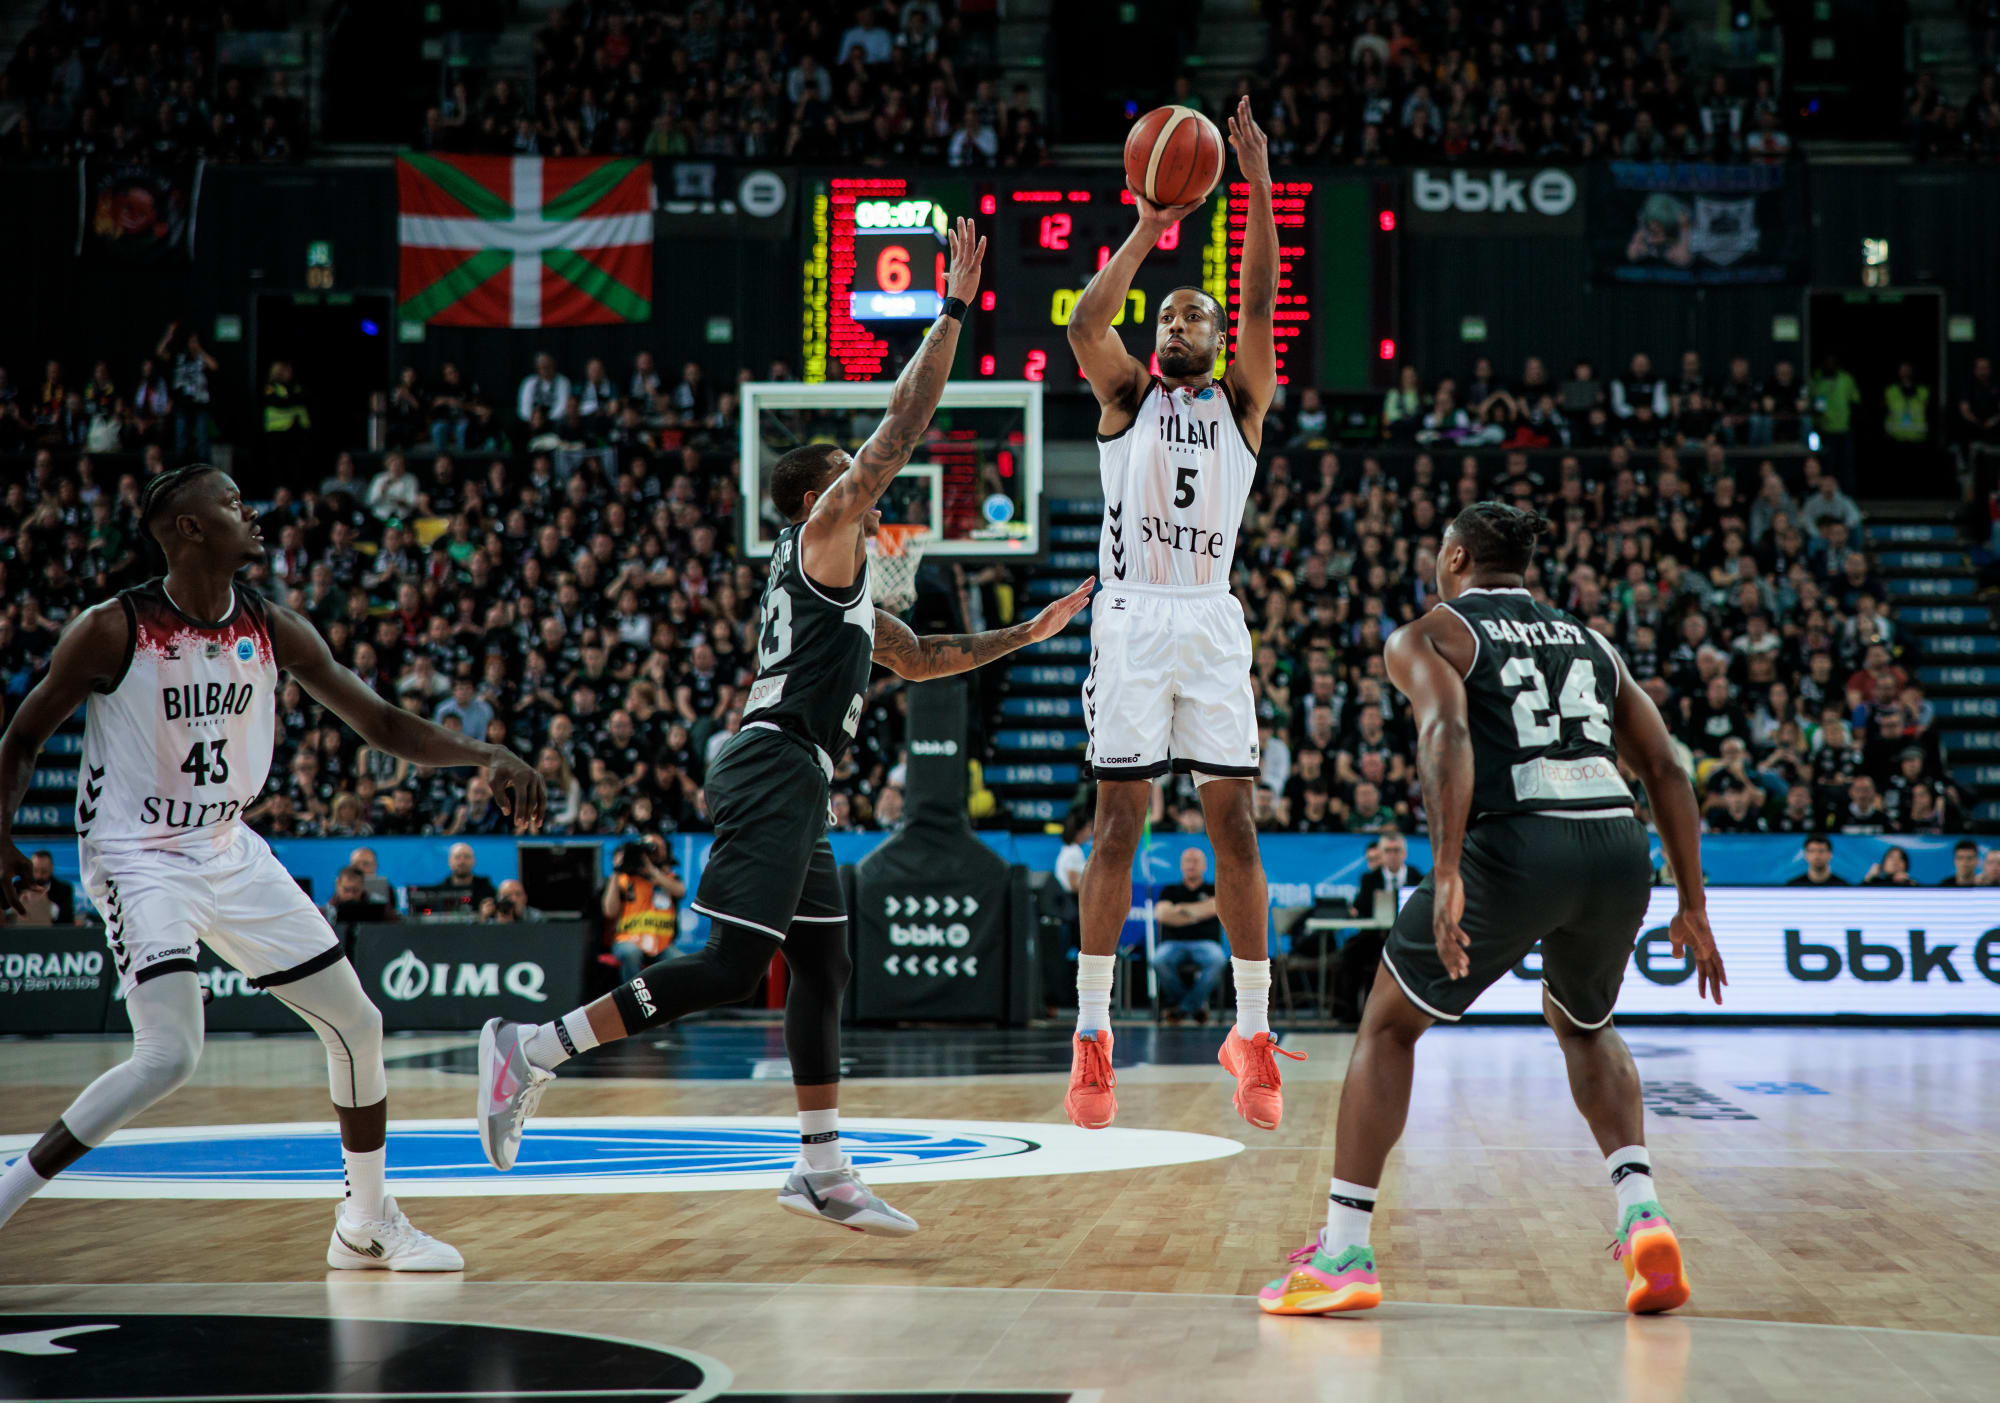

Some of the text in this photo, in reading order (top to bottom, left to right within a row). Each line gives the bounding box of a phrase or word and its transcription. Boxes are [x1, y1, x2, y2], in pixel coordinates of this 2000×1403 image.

[1413, 168, 1527, 213] bbk
[1040, 213, 1072, 250] 12
[876, 245, 911, 293] 6
[1024, 350, 1047, 381] 2
[1173, 467, 1198, 508] 5
[162, 682, 253, 721] BILBAO
[1500, 656, 1613, 748] 24
[1018, 732, 1066, 750] IMQ
[1106, 756, 1139, 764] CORREO
[181, 739, 228, 787] 43
[1005, 765, 1054, 785] IMQ
[889, 922, 946, 947] bbk
[1784, 929, 1964, 984] bbk
[430, 961, 549, 1003] IMQ
[632, 977, 658, 1019] GSA
